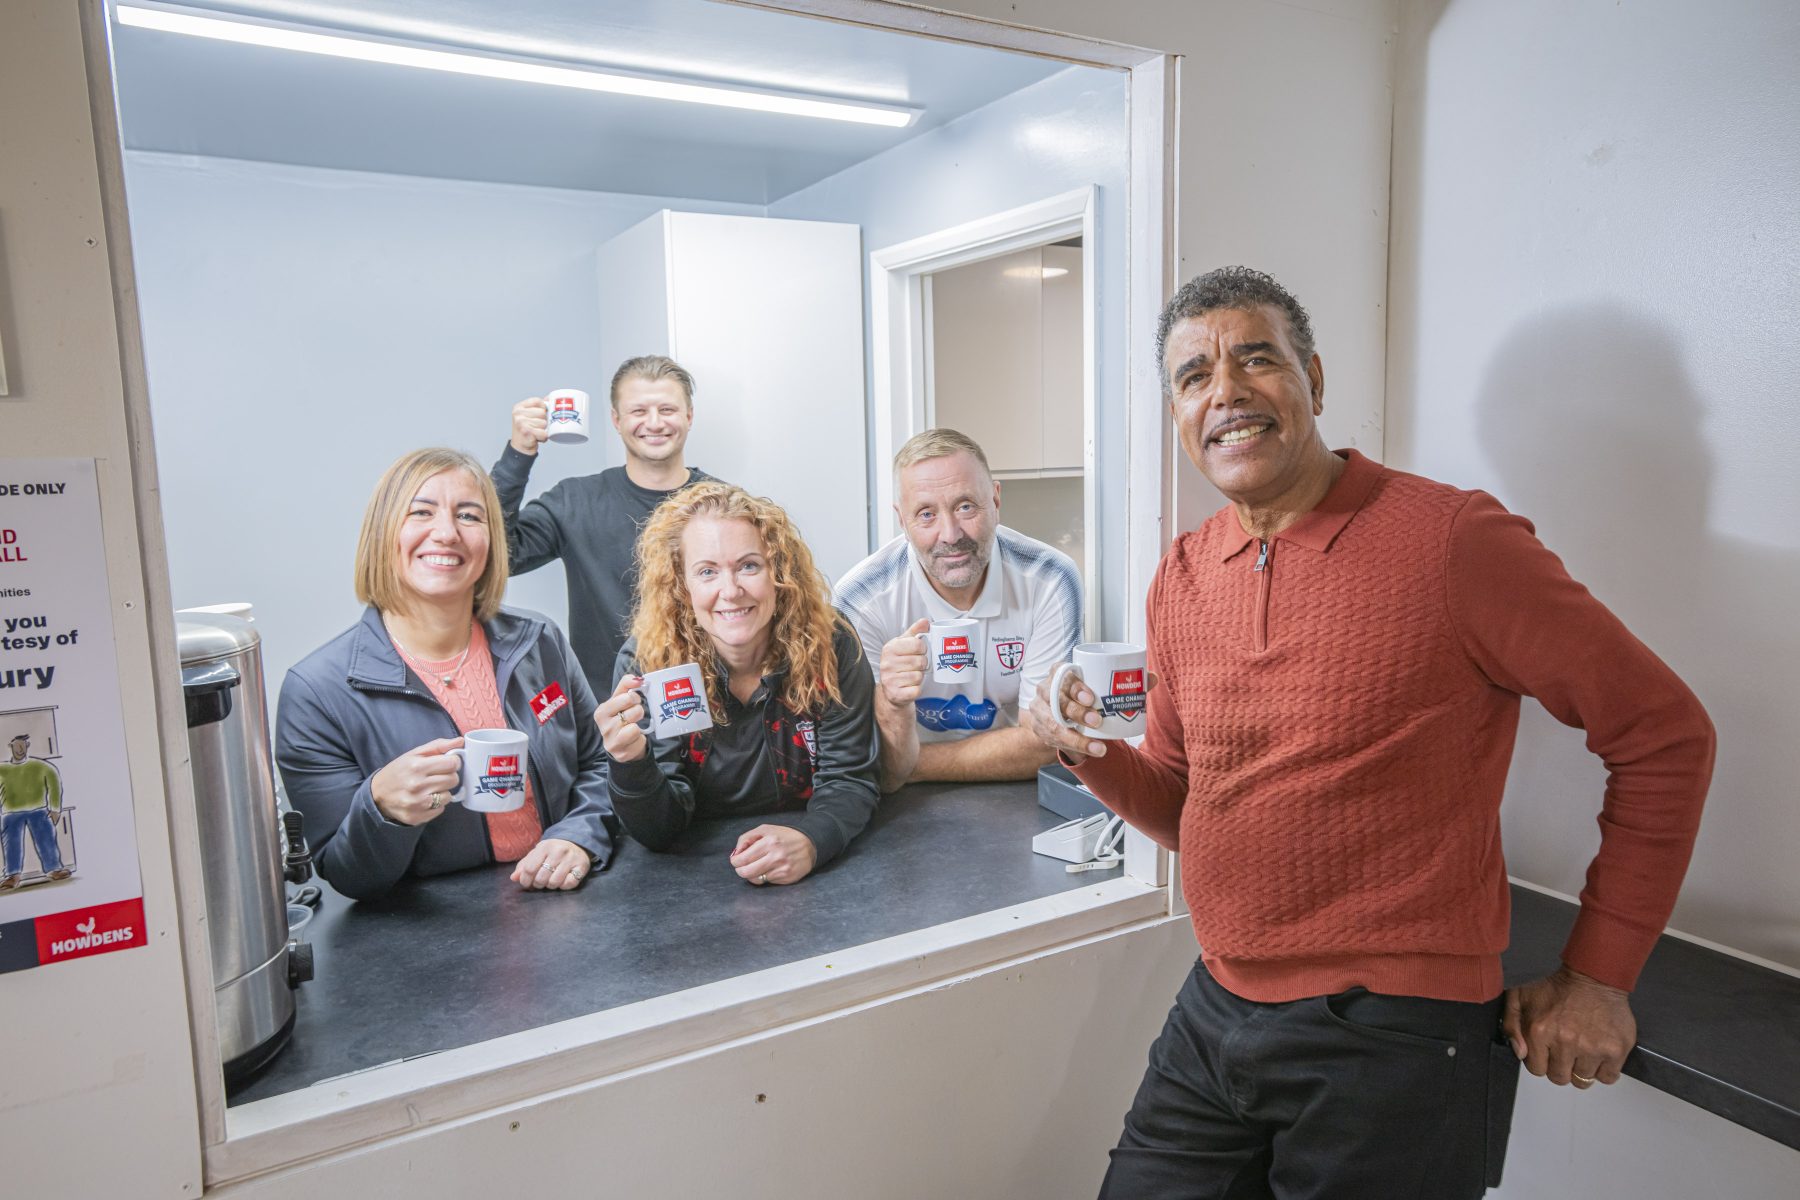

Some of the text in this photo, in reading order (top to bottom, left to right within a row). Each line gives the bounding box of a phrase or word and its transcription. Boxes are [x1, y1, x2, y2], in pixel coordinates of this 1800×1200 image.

[23, 482, 66, 495] ONLY
[0, 529, 17, 545] D
[0, 546, 28, 562] LL
[4, 616, 47, 633] you
[1, 629, 78, 650] tesy of
[51, 926, 134, 955] HOWDENS
